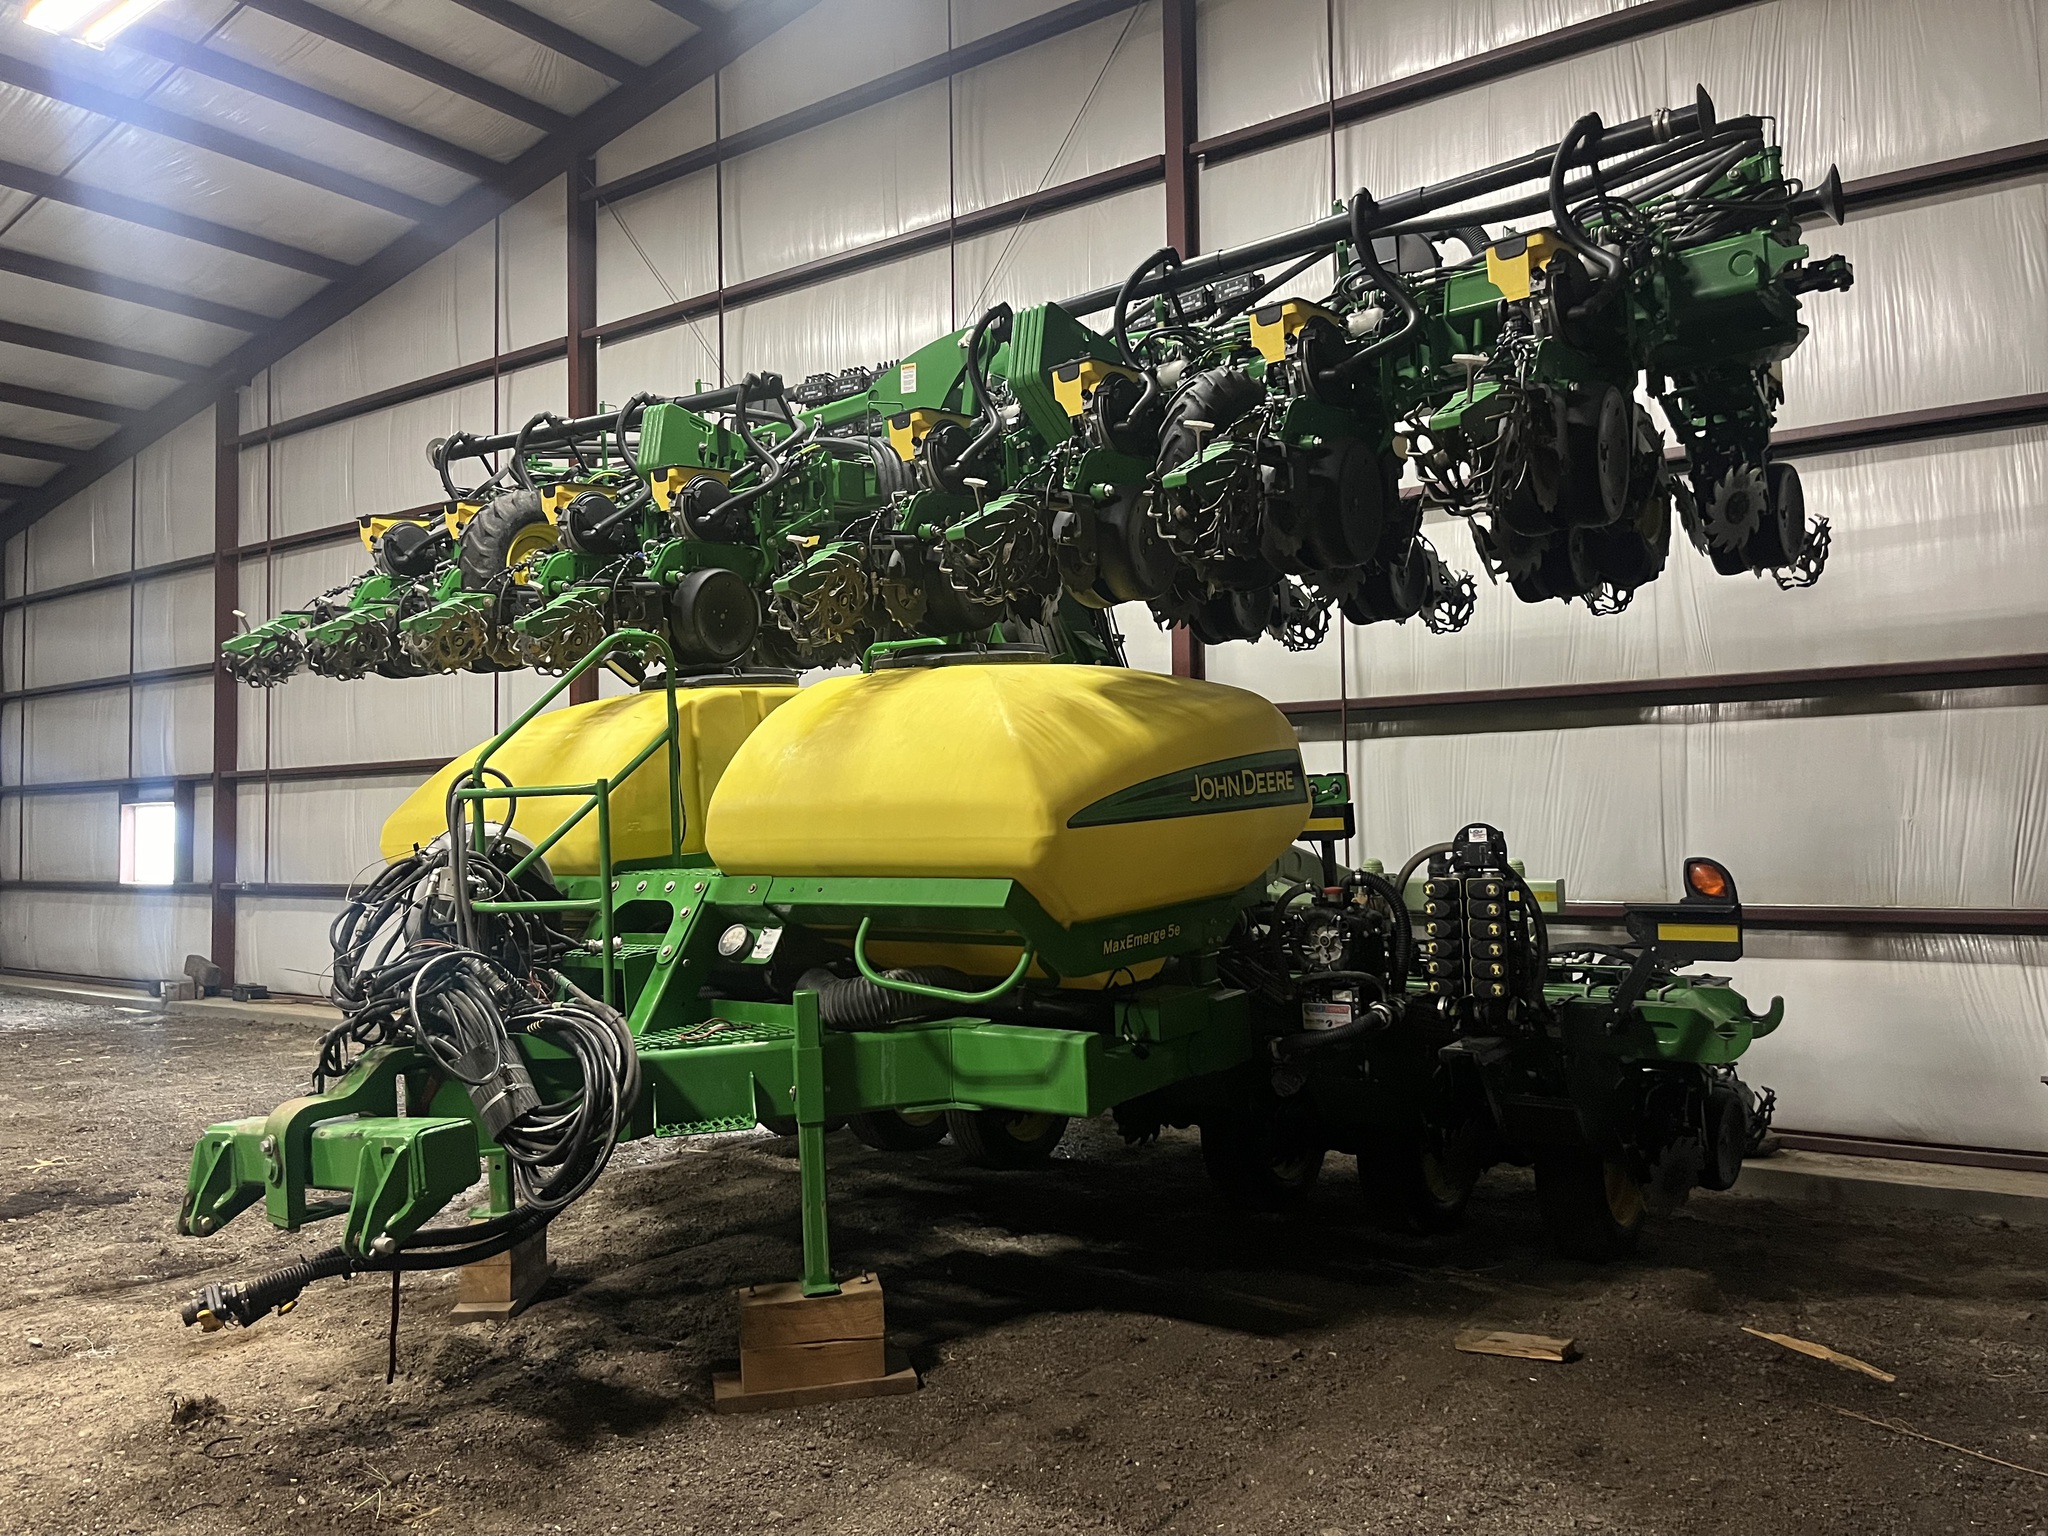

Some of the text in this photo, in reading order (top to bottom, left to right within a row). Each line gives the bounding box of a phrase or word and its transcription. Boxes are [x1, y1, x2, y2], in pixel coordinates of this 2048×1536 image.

[1190, 769, 1294, 802] JOHN DEERE
[1103, 923, 1181, 955] MaxEmerge 5e
